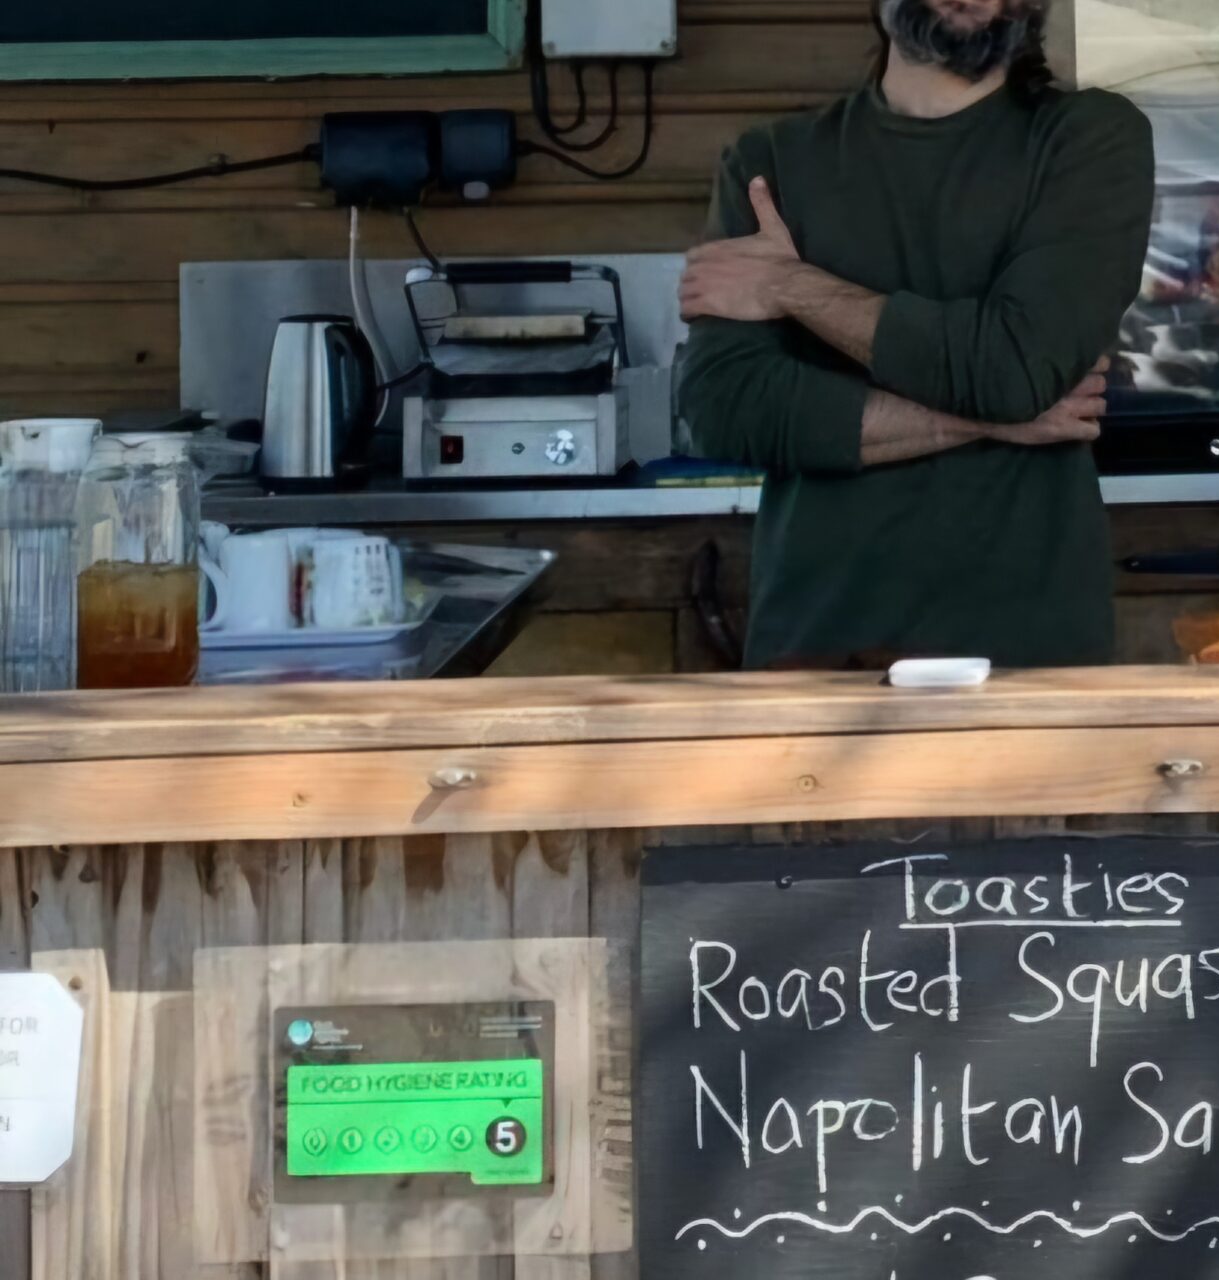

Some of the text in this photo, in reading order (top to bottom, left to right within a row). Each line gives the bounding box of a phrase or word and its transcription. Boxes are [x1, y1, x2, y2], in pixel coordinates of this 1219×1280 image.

[860, 853, 1190, 920] Toasties
[689, 925, 960, 1032] Roasted
[495, 1121, 517, 1153] 5
[688, 1050, 1082, 1194] Napolitan
